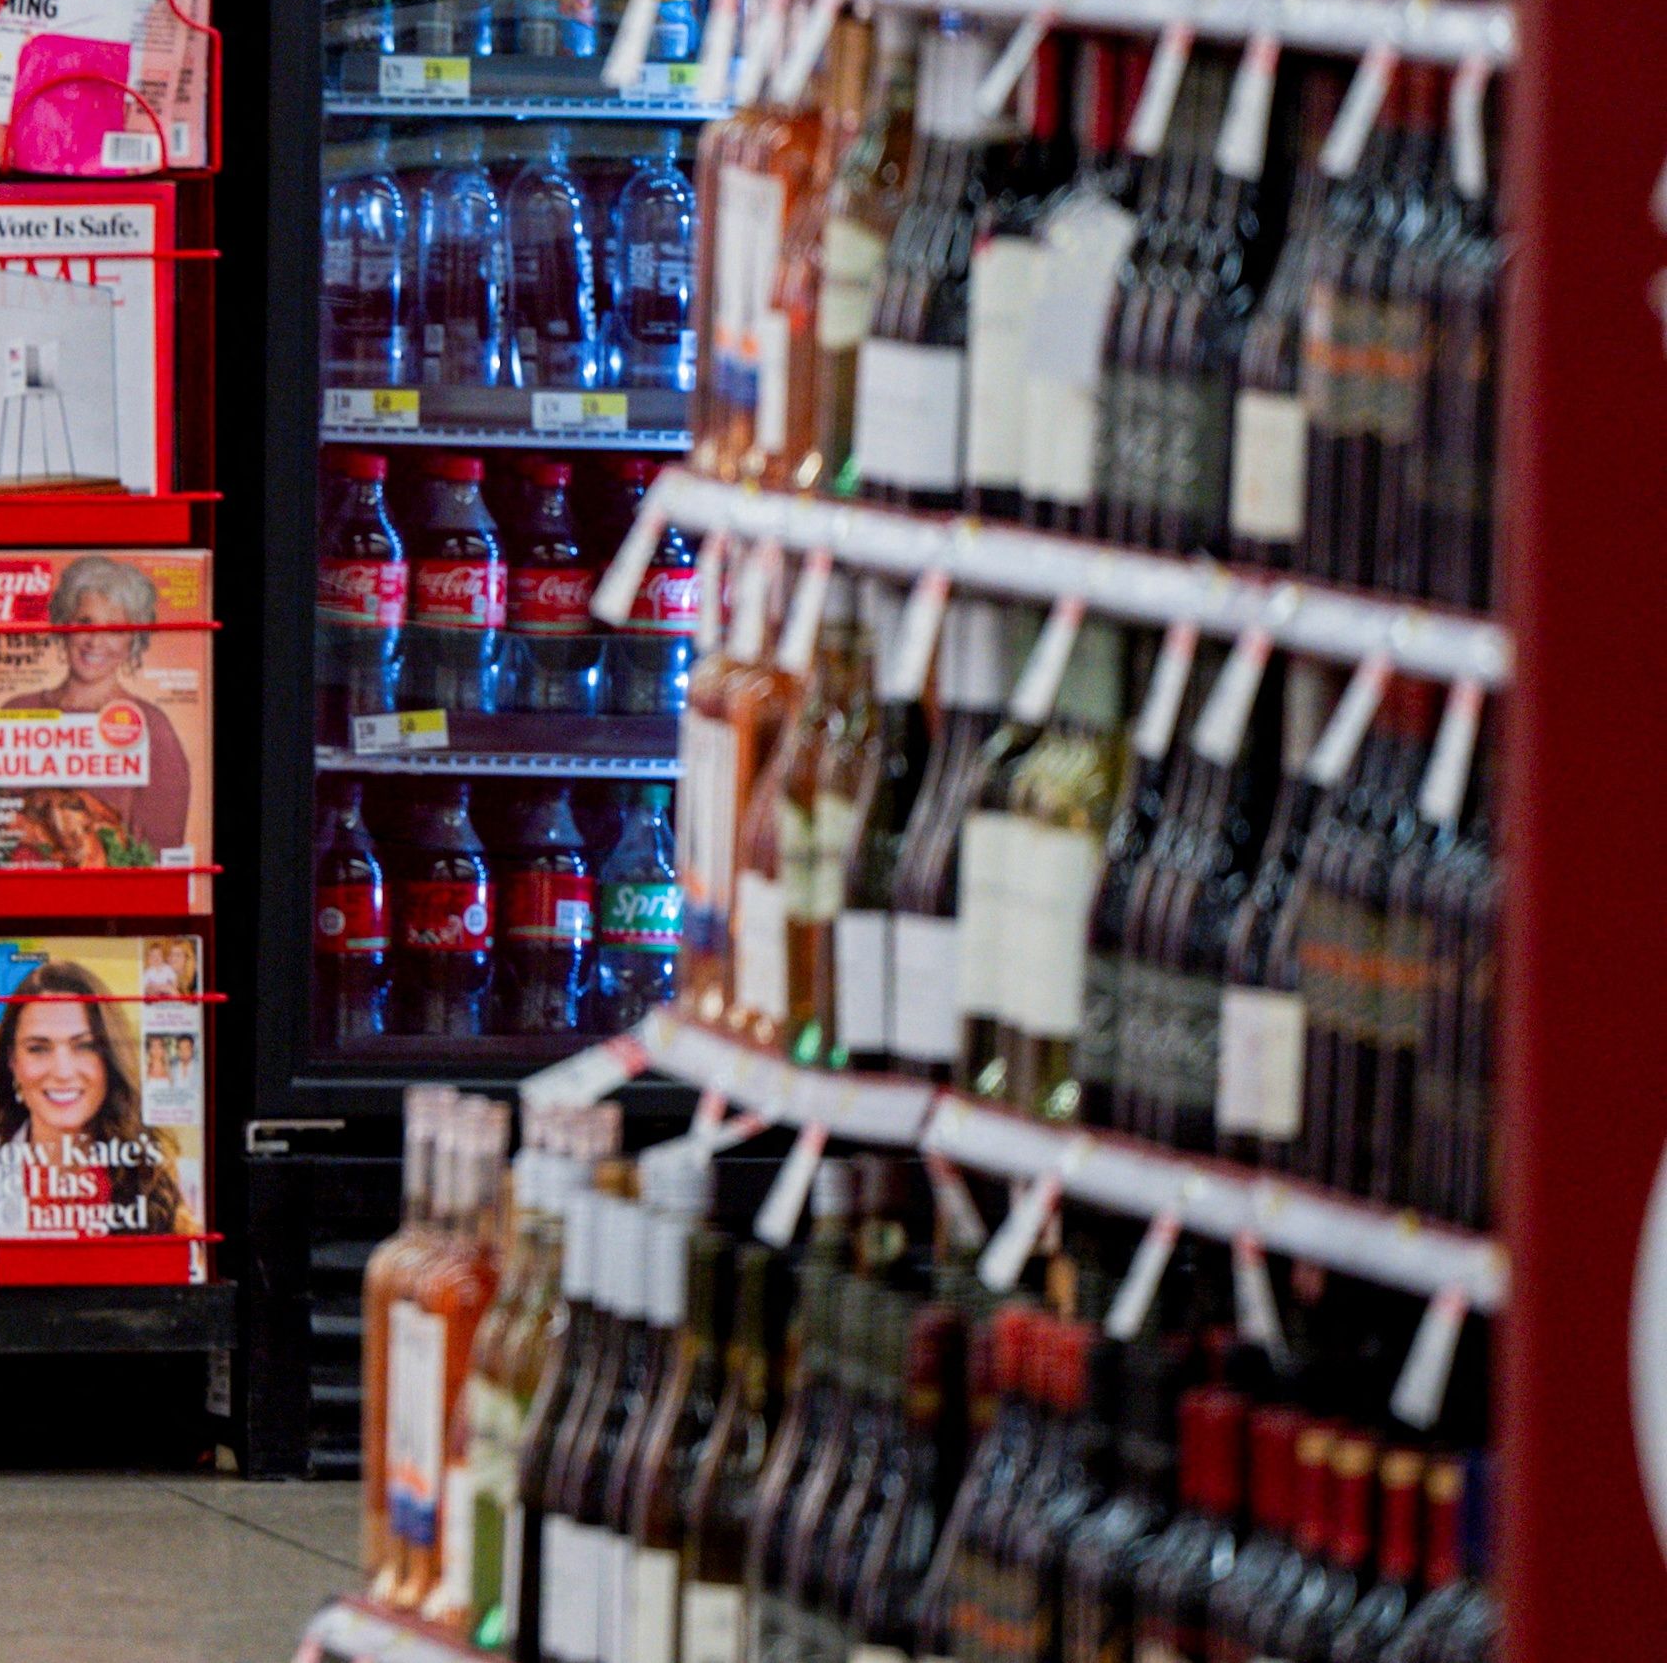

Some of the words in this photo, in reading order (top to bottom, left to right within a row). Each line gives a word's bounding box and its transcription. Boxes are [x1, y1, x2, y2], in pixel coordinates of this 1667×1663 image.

[54, 216, 76, 237] Is
[79, 212, 140, 238] Safe.
[13, 727, 94, 749] HOME
[66, 754, 141, 776] DEEN
[62, 1133, 165, 1168] Kate's
[28, 1164, 99, 1198] Has
